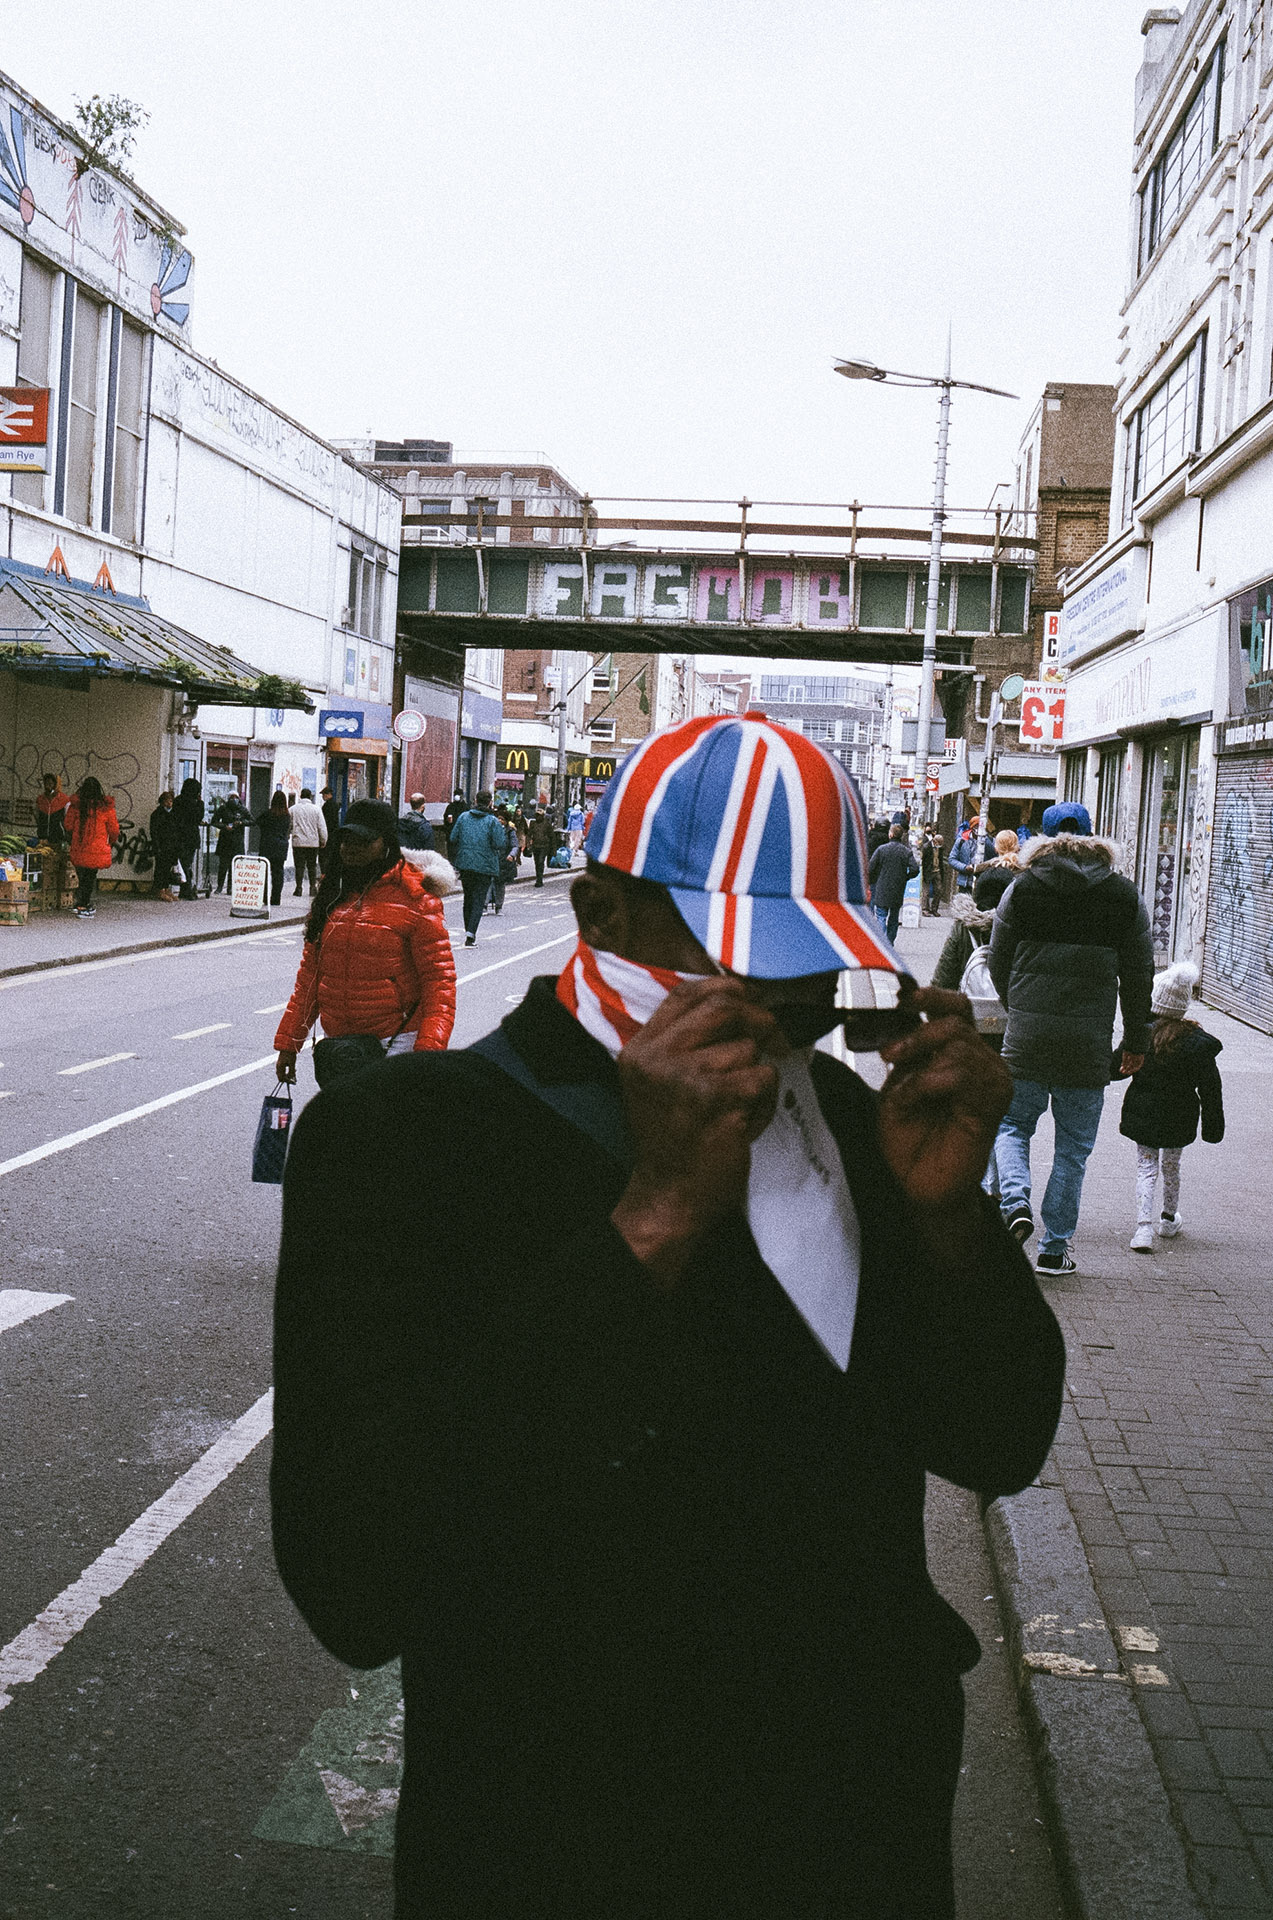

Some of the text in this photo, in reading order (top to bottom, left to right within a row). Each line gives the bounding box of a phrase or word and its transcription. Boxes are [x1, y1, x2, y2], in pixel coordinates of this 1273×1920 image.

[16, 450, 35, 462] Rye
[1048, 616, 1060, 636] B
[1047, 638, 1059, 658] C
[1023, 686, 1066, 695] ANY ITEM
[1021, 696, 1065, 740] £1
